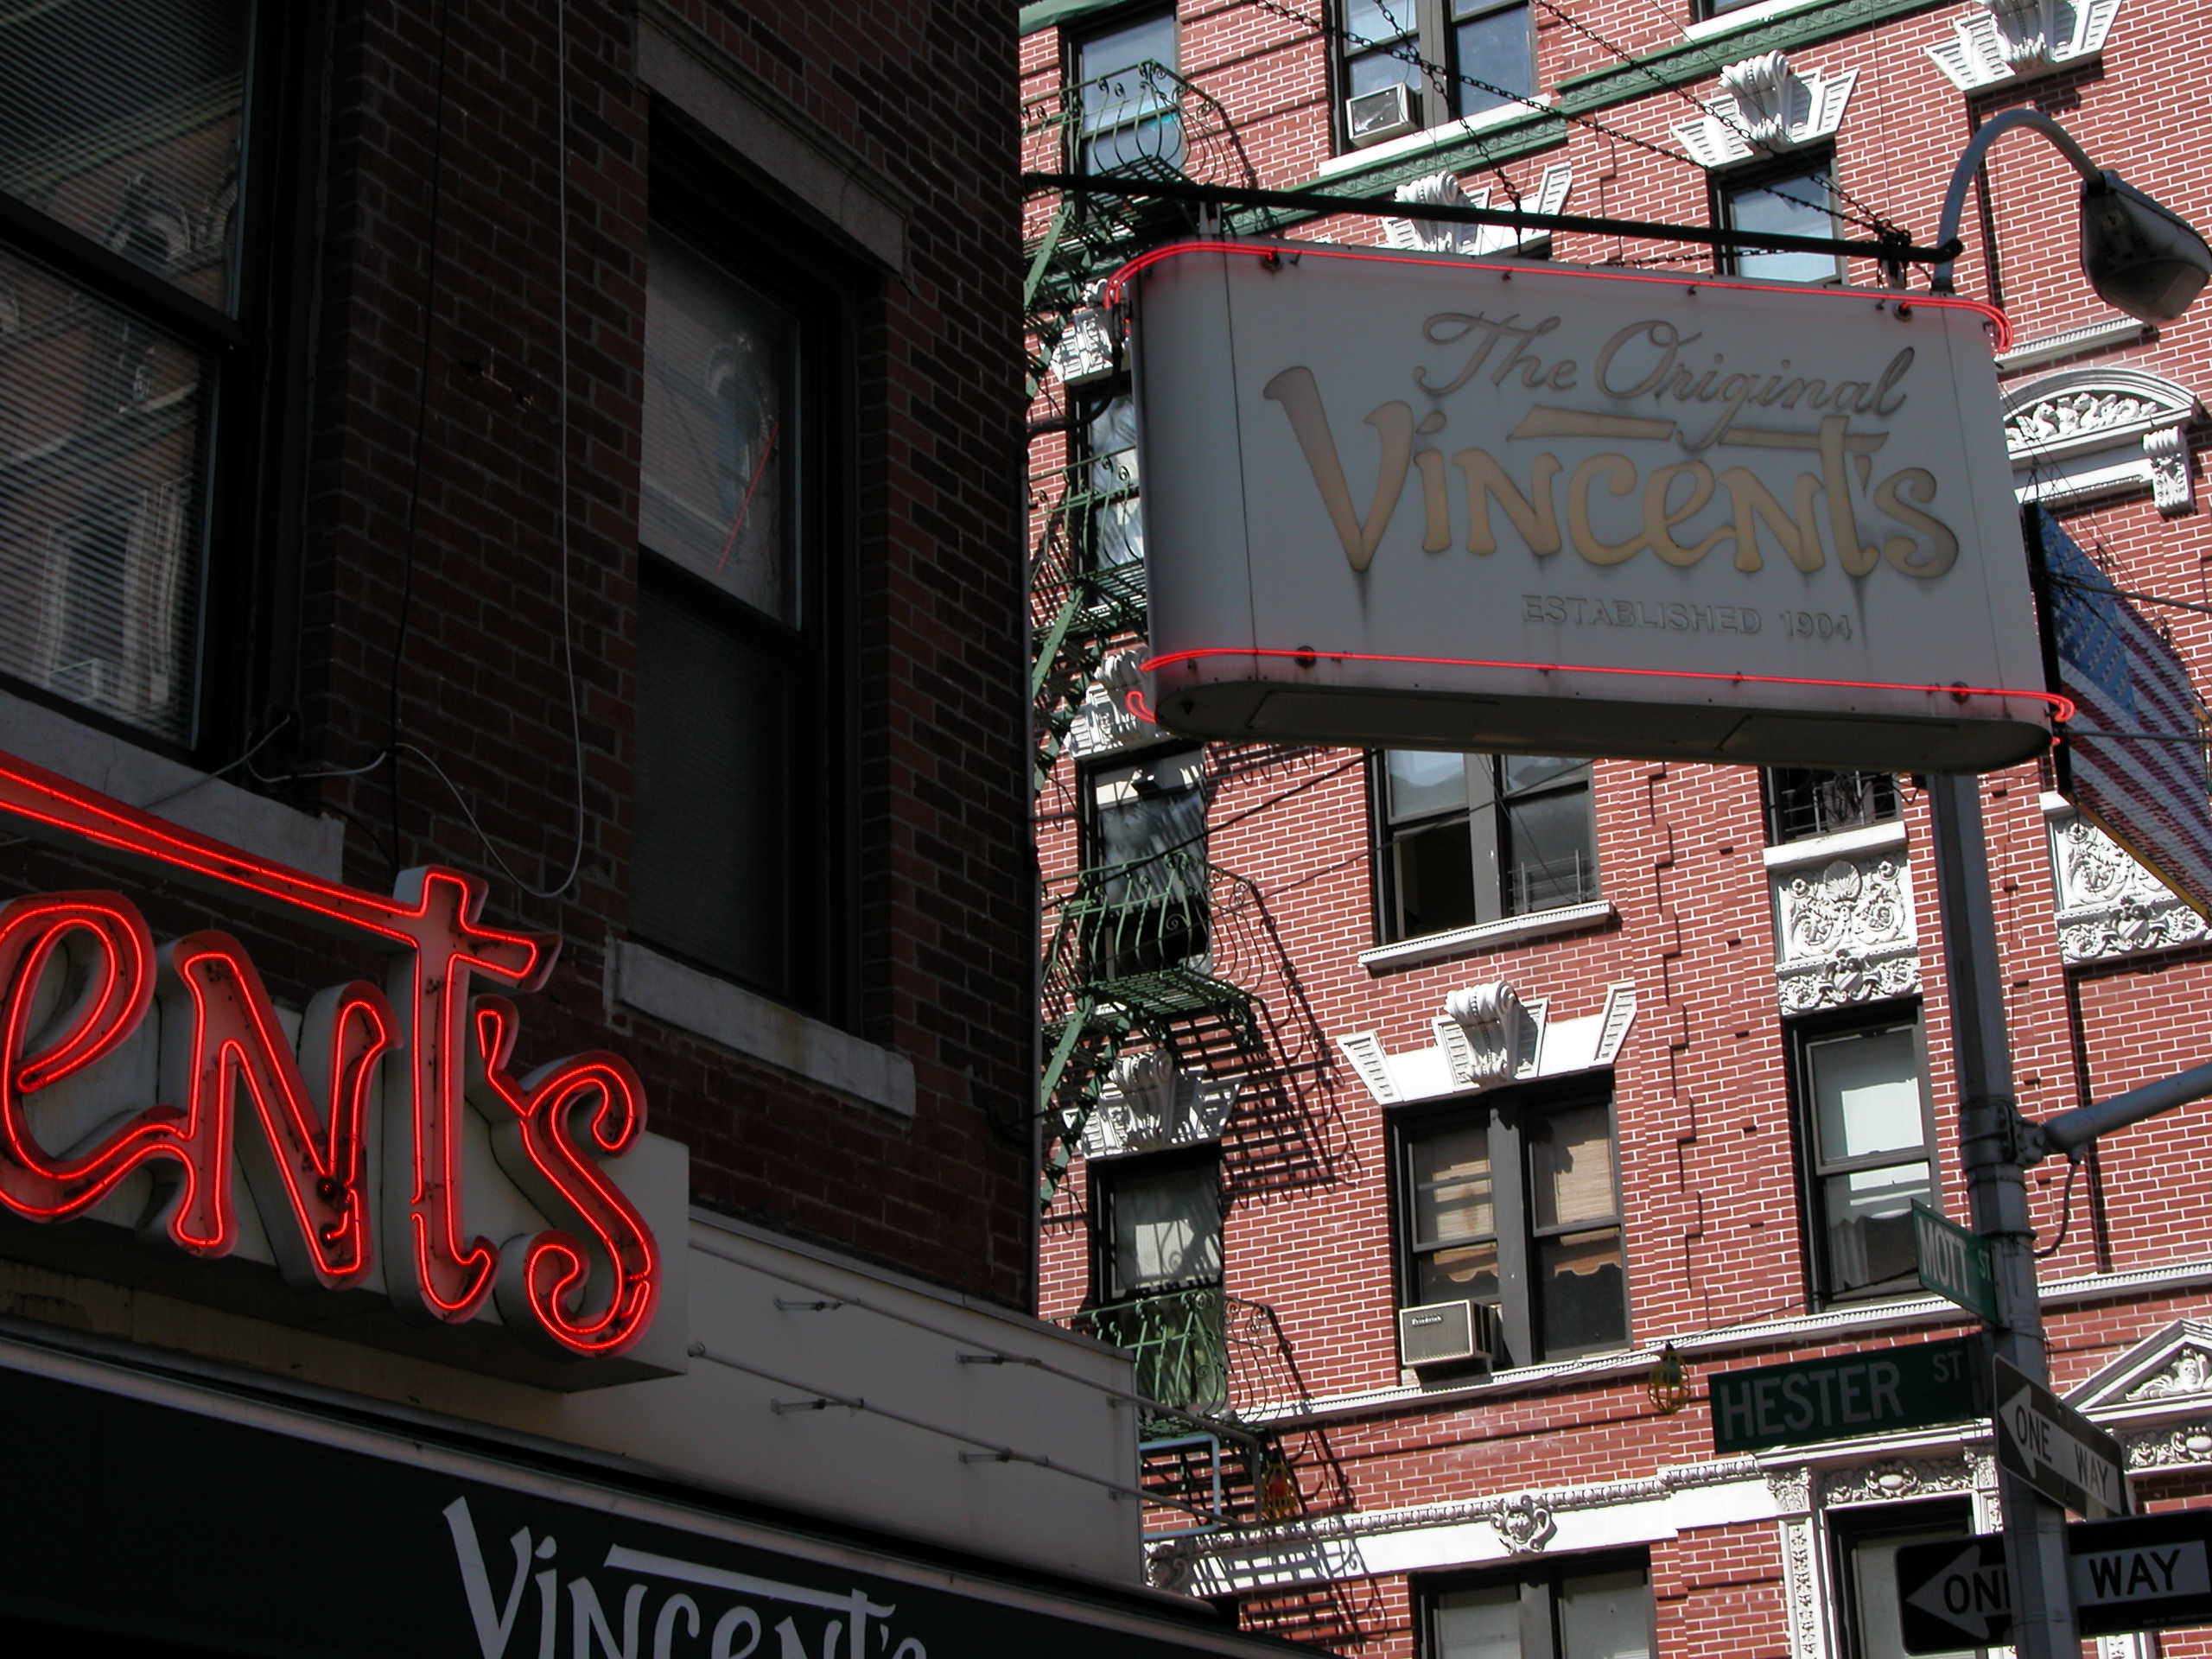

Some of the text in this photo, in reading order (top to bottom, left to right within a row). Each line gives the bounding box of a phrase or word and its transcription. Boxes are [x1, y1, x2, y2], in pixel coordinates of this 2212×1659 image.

[1414, 310, 1915, 453] The Original
[1521, 594, 1853, 641] ESTABLISHED 1904
[1917, 1215, 1970, 1298] MOTT
[1719, 1350, 1973, 1441] HESTER ST
[2015, 1404, 2109, 1501] ONE WAY
[442, 1495, 927, 1659] Vincent'
[2088, 1548, 2181, 1599] WAY
